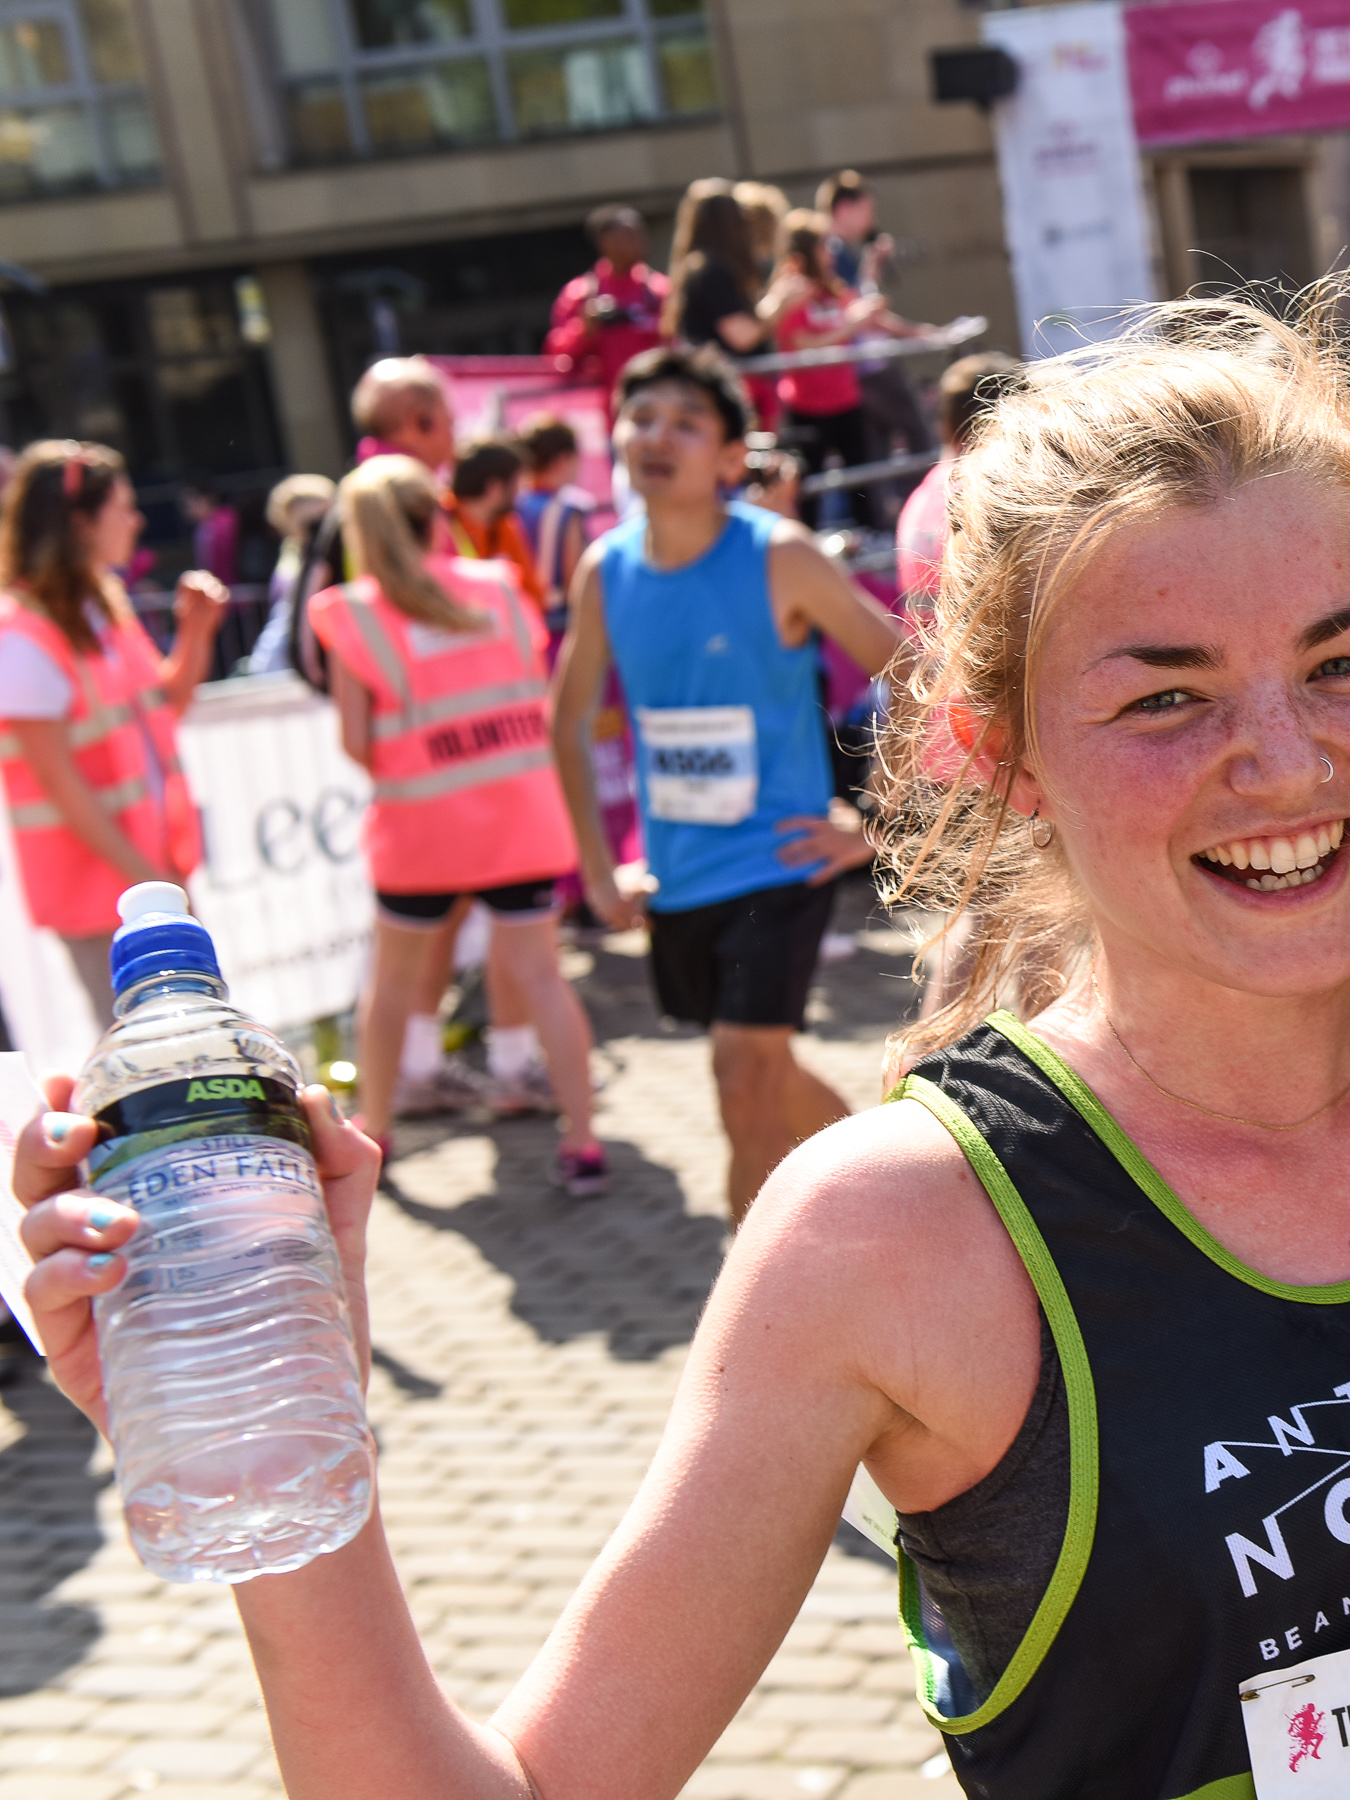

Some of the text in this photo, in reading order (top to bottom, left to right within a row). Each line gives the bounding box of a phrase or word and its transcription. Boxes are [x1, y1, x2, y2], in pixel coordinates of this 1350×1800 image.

[186, 1079, 267, 1103] ASDA
[201, 1135, 253, 1150] STILL
[128, 1160, 216, 1205] EDEN
[1259, 1626, 1302, 1661] BE
[1314, 1611, 1330, 1634] A
